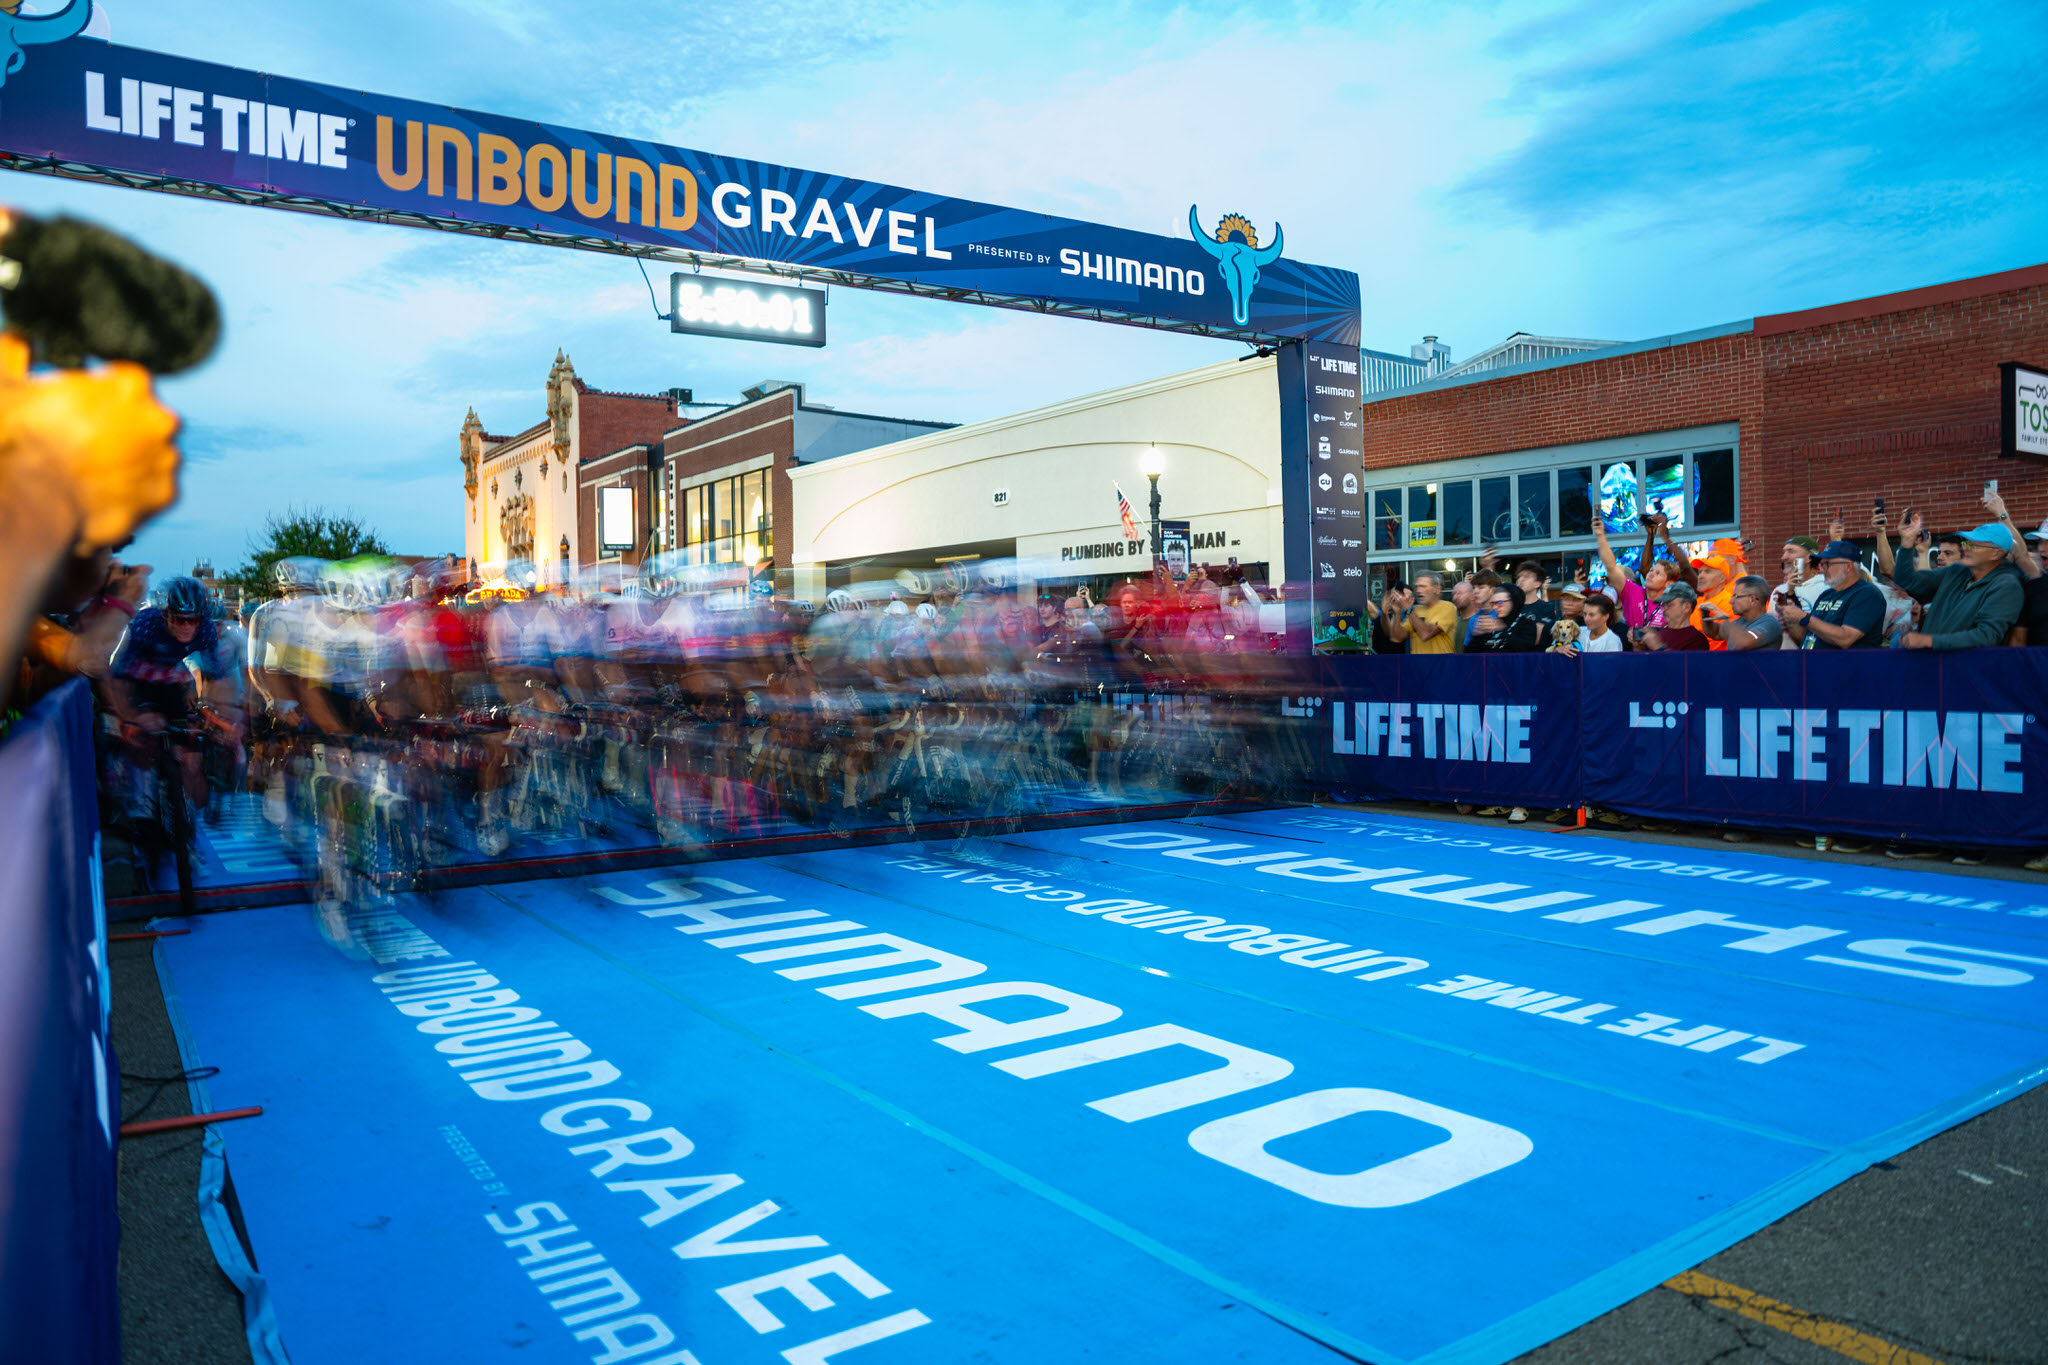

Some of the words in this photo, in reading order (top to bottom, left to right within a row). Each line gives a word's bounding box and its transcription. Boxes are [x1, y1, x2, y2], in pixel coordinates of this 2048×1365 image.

[85, 71, 204, 146] LIFE
[212, 95, 348, 169] TIME
[376, 114, 698, 232] UNBOUND
[711, 182, 952, 260] GRAVEL
[968, 243, 1033, 262] PRESENTED
[1033, 253, 1051, 265] BY
[1060, 248, 1205, 296] SHIMANO
[1315, 386, 1354, 398] SHIMANO
[1321, 358, 1337, 372] LIFE
[1338, 360, 1357, 375] TIME
[2022, 434, 2038, 444] FAMILY
[994, 491, 1007, 502] 821
[1061, 540, 1125, 562] PLUMBING
[1127, 539, 1146, 557] BY
[1343, 566, 1363, 577] stelo
[1332, 701, 1412, 758] LIFE
[1416, 703, 1531, 763] TIME
[1705, 707, 1828, 782] LIFE
[1838, 709, 2024, 794] TIME
[1279, 818, 1491, 848] GRAVEL
[884, 855, 1086, 902] GRAVEL
[1489, 845, 1833, 890] UNBOUND
[1080, 832, 2048, 987] SHIMANO
[1064, 899, 1430, 981] UNBOUND
[1416, 974, 1618, 1025] TIME
[589, 876, 1534, 1208] SHIMANO
[1597, 1012, 1807, 1065] LIFE
[372, 960, 622, 1101] UNBOUND
[540, 1098, 932, 1365] GRAVEL
[484, 1201, 702, 1365] SHIMA
